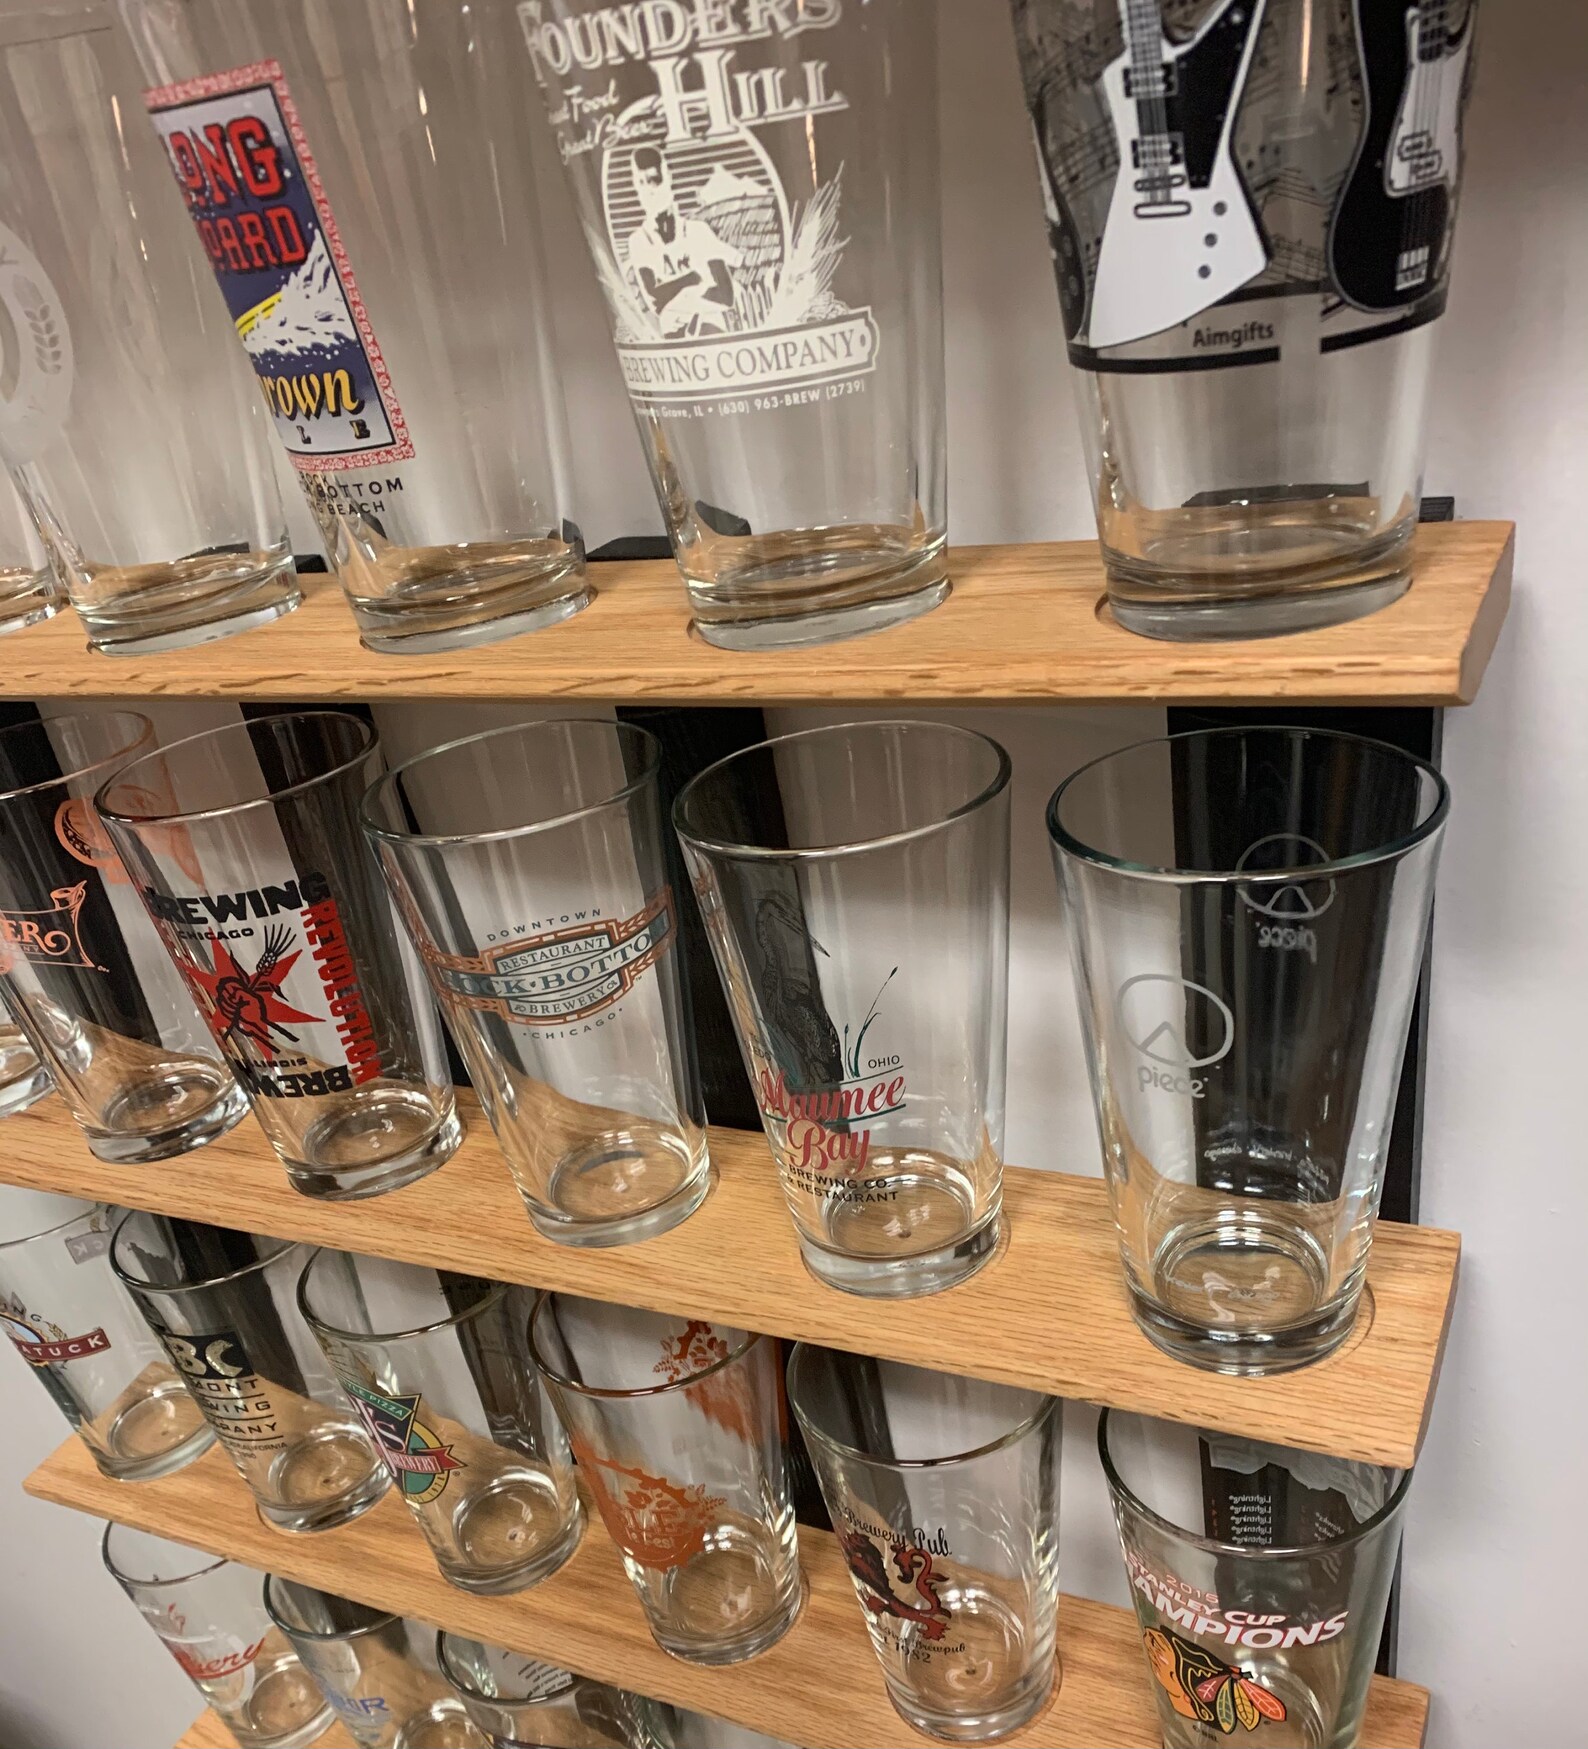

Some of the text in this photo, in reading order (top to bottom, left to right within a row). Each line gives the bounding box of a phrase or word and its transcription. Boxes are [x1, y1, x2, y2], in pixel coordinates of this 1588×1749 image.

[650, 47, 850, 142] HILL
[168, 115, 283, 204] ONG
[200, 206, 307, 272] OARD
[1193, 322, 1275, 350] Aimgifts
[622, 327, 857, 385] BREWING COMPANY
[262, 366, 362, 421] rown
[718, 399, 750, 416] (630)
[754, 388, 821, 412] 963-BREW
[825, 377, 866, 401] (2739)
[315, 477, 404, 499] BOTTOM
[326, 500, 385, 515] BEACH
[176, 927, 255, 941] CHICAGO
[486, 907, 601, 942] DOWNTOWN
[500, 936, 607, 972] RESTAURANT
[540, 931, 652, 989] BOTTO
[300, 897, 384, 1086] REVOLUTION
[529, 987, 605, 1015] BREWERY
[531, 1011, 617, 1040] CHICAGO
[867, 1054, 901, 1070] OHIO
[759, 1066, 907, 1121] Maumee
[1137, 1065, 1206, 1099] piece
[786, 1117, 871, 1176] Bay
[788, 1164, 892, 1190] BREWING CO.
[797, 1180, 899, 1203] RESTAURANT
[368, 1394, 404, 1417] PIZZA
[844, 1506, 909, 1550] Brewery
[1128, 1551, 1288, 1627] STANLEY CUP
[1165, 1573, 1220, 1605] 2015
[1131, 1566, 1349, 1649] AMPIONS
